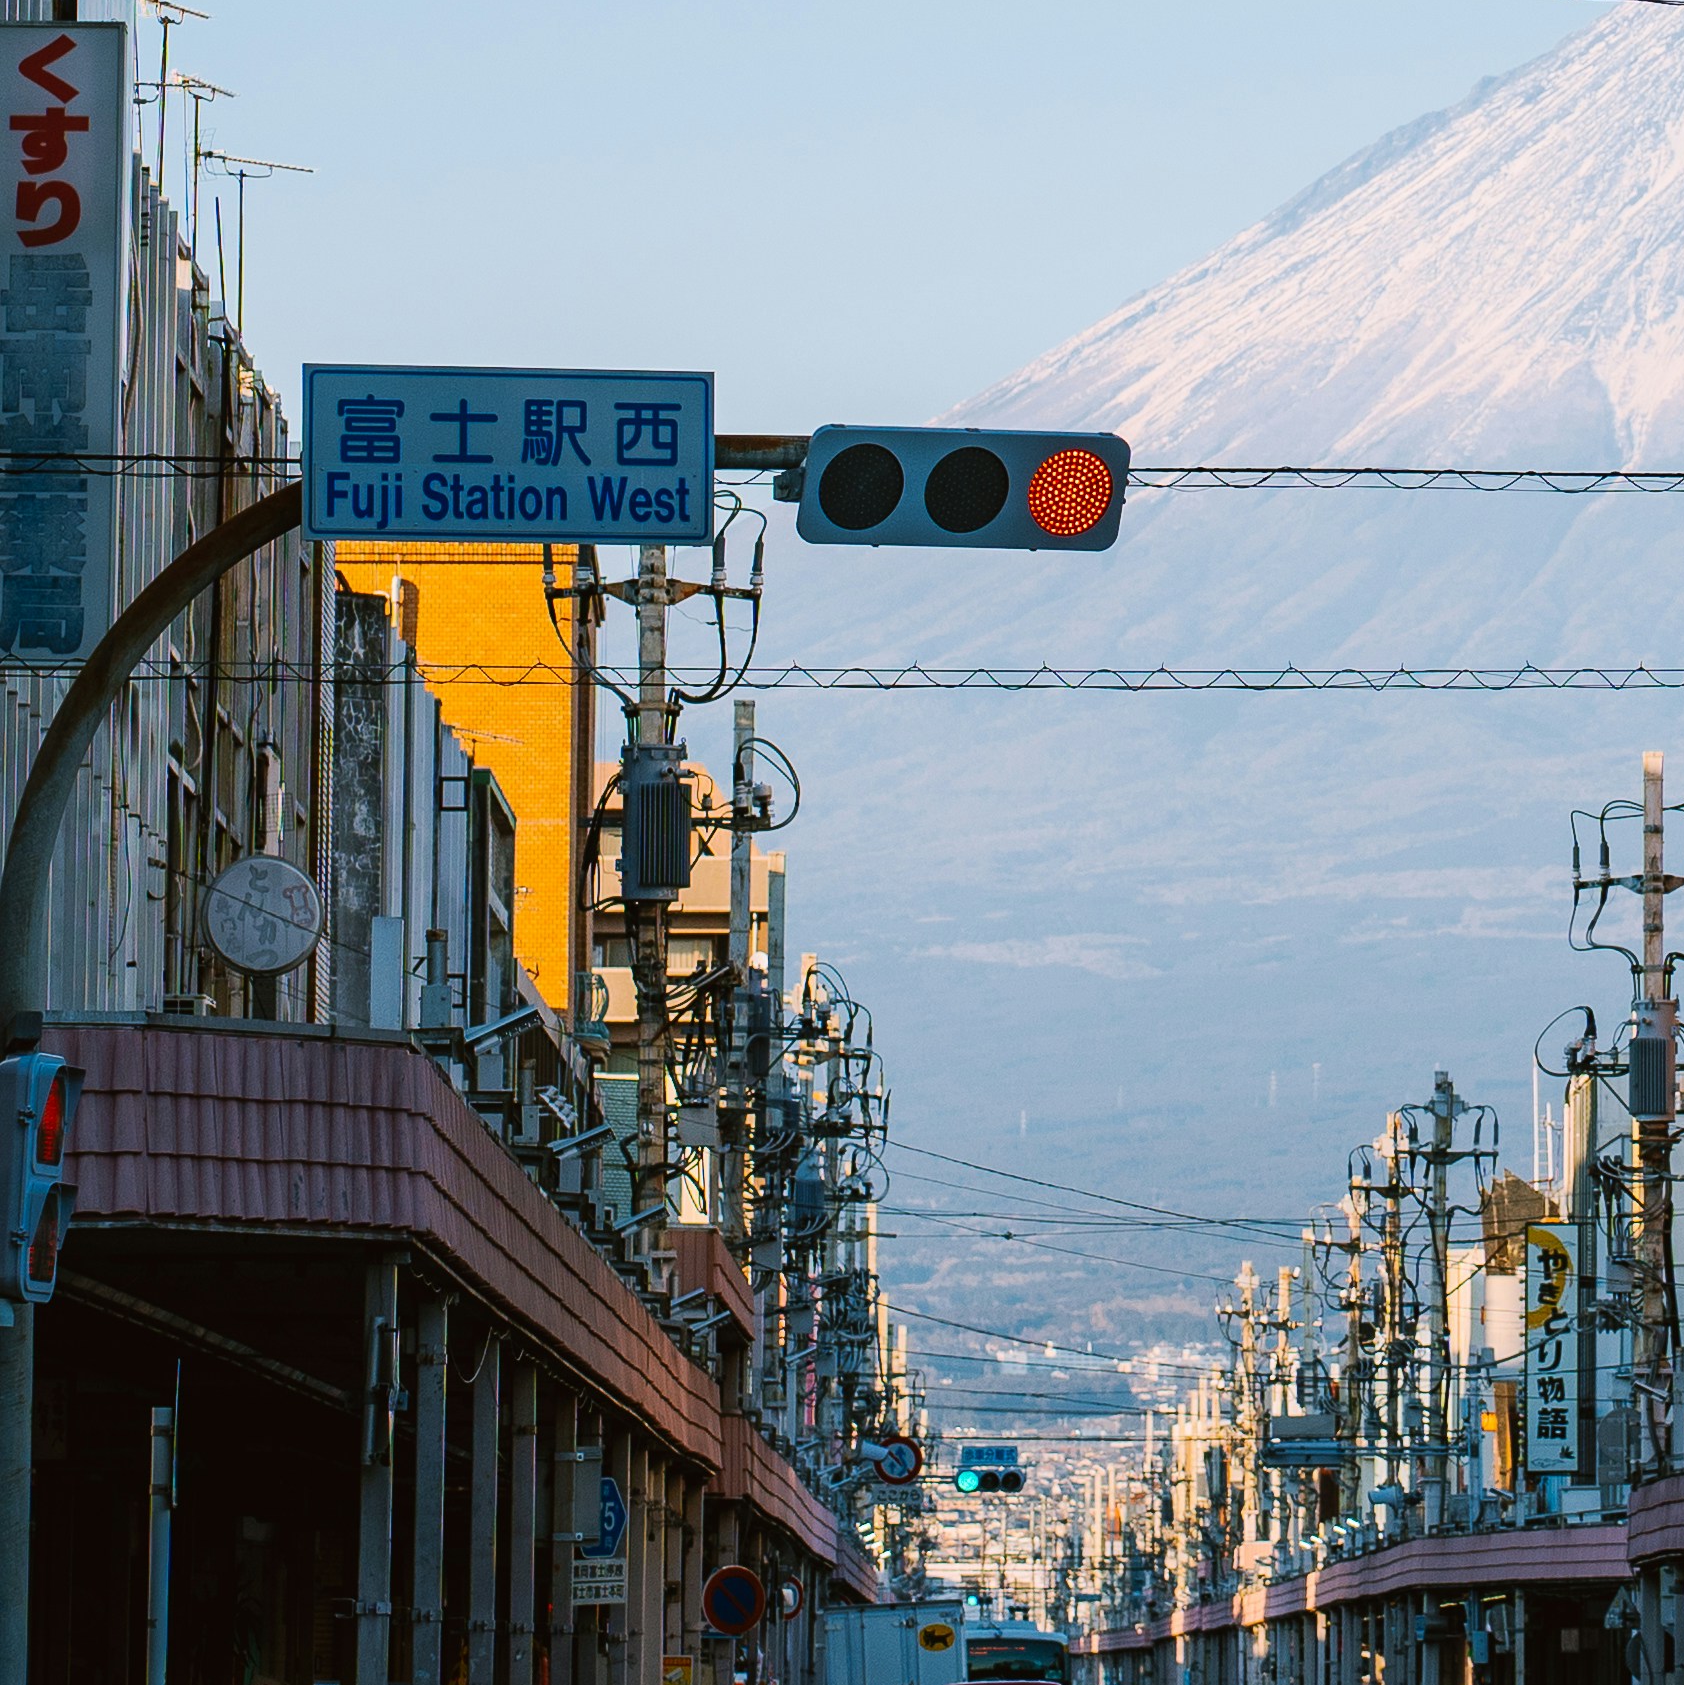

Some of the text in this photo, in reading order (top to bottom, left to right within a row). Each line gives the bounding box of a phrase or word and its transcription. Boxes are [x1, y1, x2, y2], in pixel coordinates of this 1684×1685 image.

[9, 33, 91, 249] くすり
[336, 393, 683, 467] 富士駅西
[326, 471, 691, 530] Fuji Station West
[1536, 1247, 1571, 1441] やきとり物語
[877, 1489, 921, 1503] ここから
